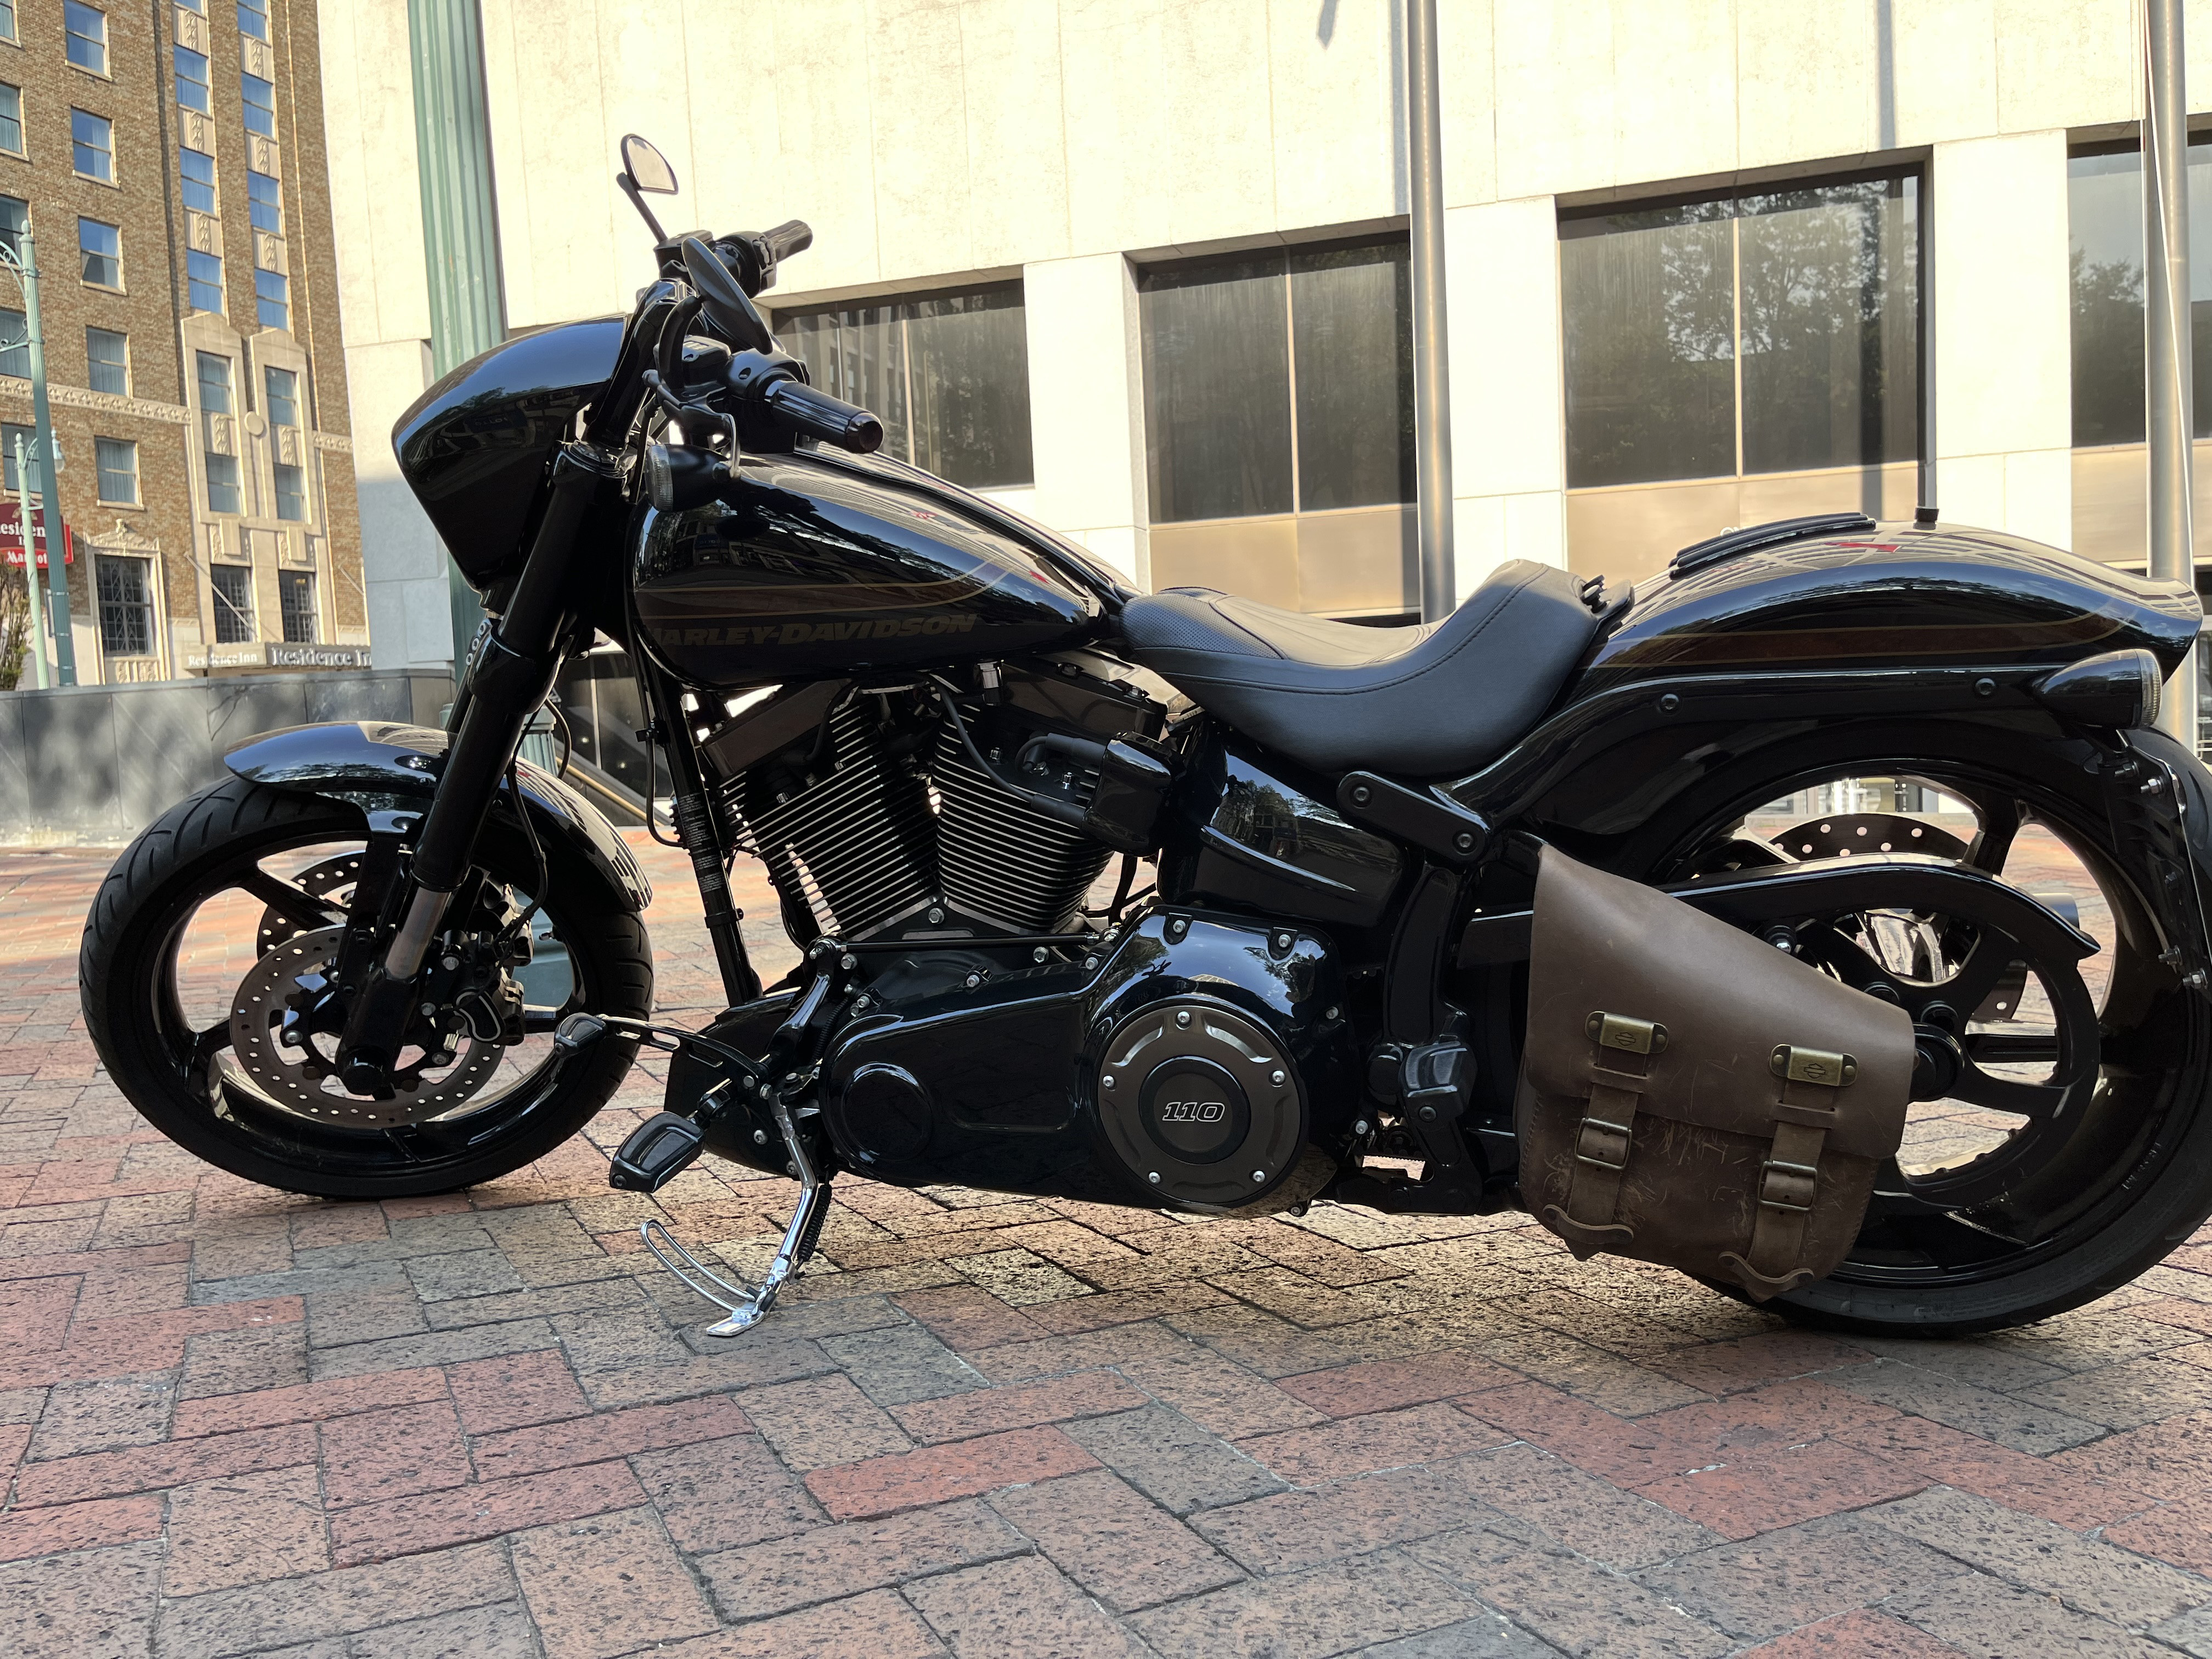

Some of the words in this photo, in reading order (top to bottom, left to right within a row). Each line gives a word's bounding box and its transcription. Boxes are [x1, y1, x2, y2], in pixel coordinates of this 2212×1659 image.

[272, 647, 352, 666] Residence
[356, 650, 372, 667] In
[1162, 1102, 1225, 1122] 110
